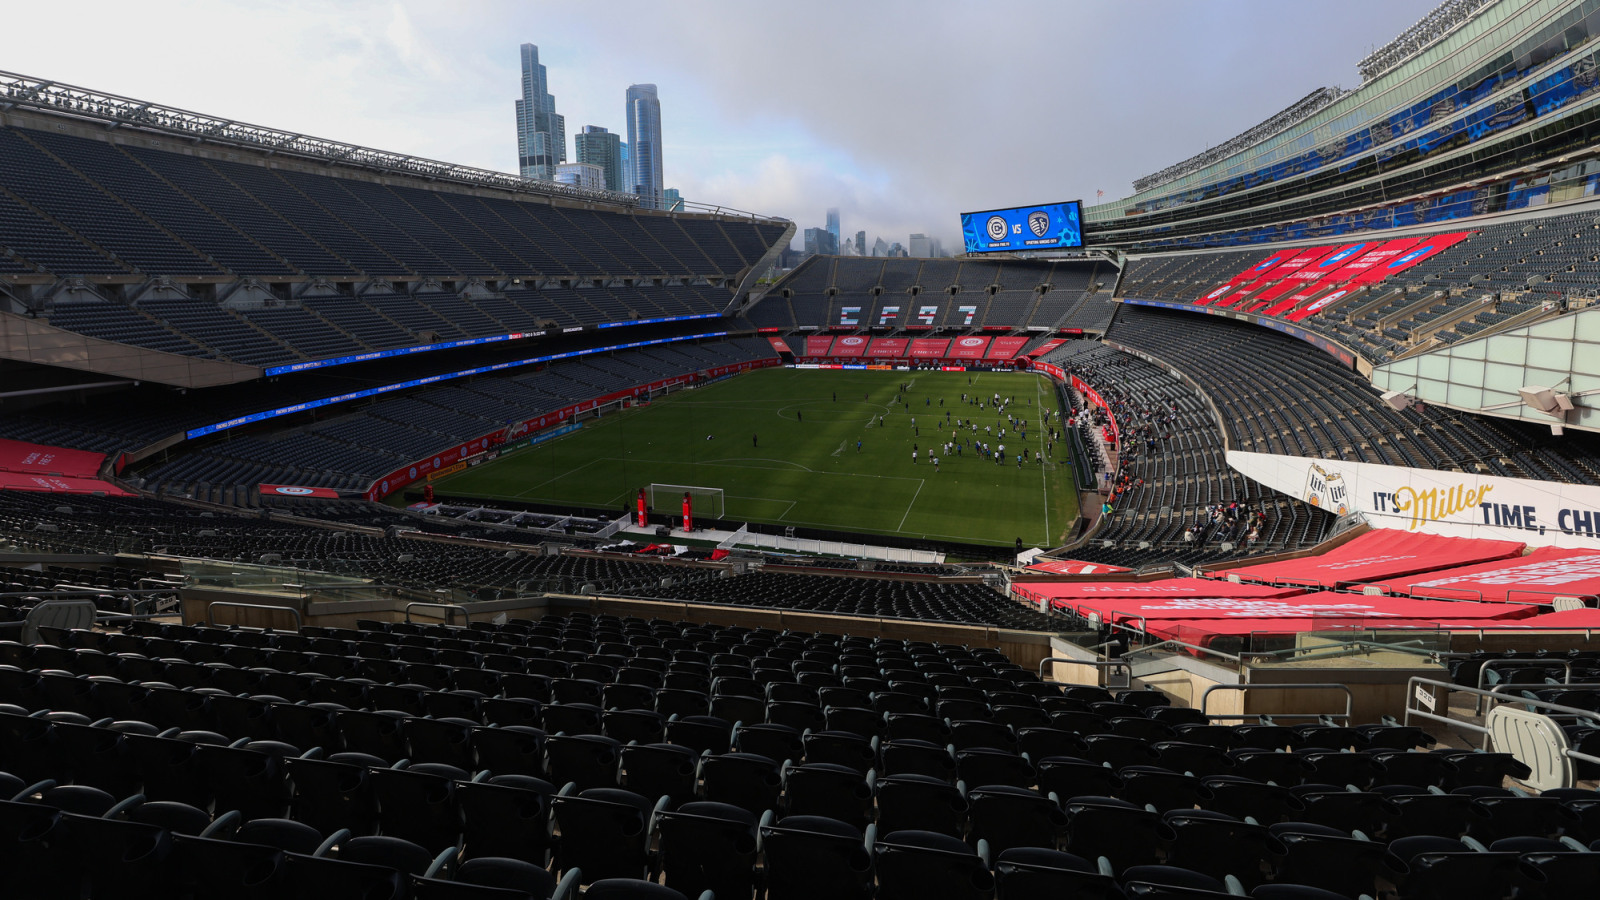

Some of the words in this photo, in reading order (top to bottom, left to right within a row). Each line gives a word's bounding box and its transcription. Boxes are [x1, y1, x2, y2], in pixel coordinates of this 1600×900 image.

[1012, 224, 1022, 234] VS
[1310, 473, 1326, 492] Lite
[1330, 483, 1346, 503] Lite
[1373, 491, 1400, 513] IT'S
[1395, 483, 1493, 531] Miller
[1479, 502, 1546, 536] TIME,
[1419, 689, 1433, 703] 320
